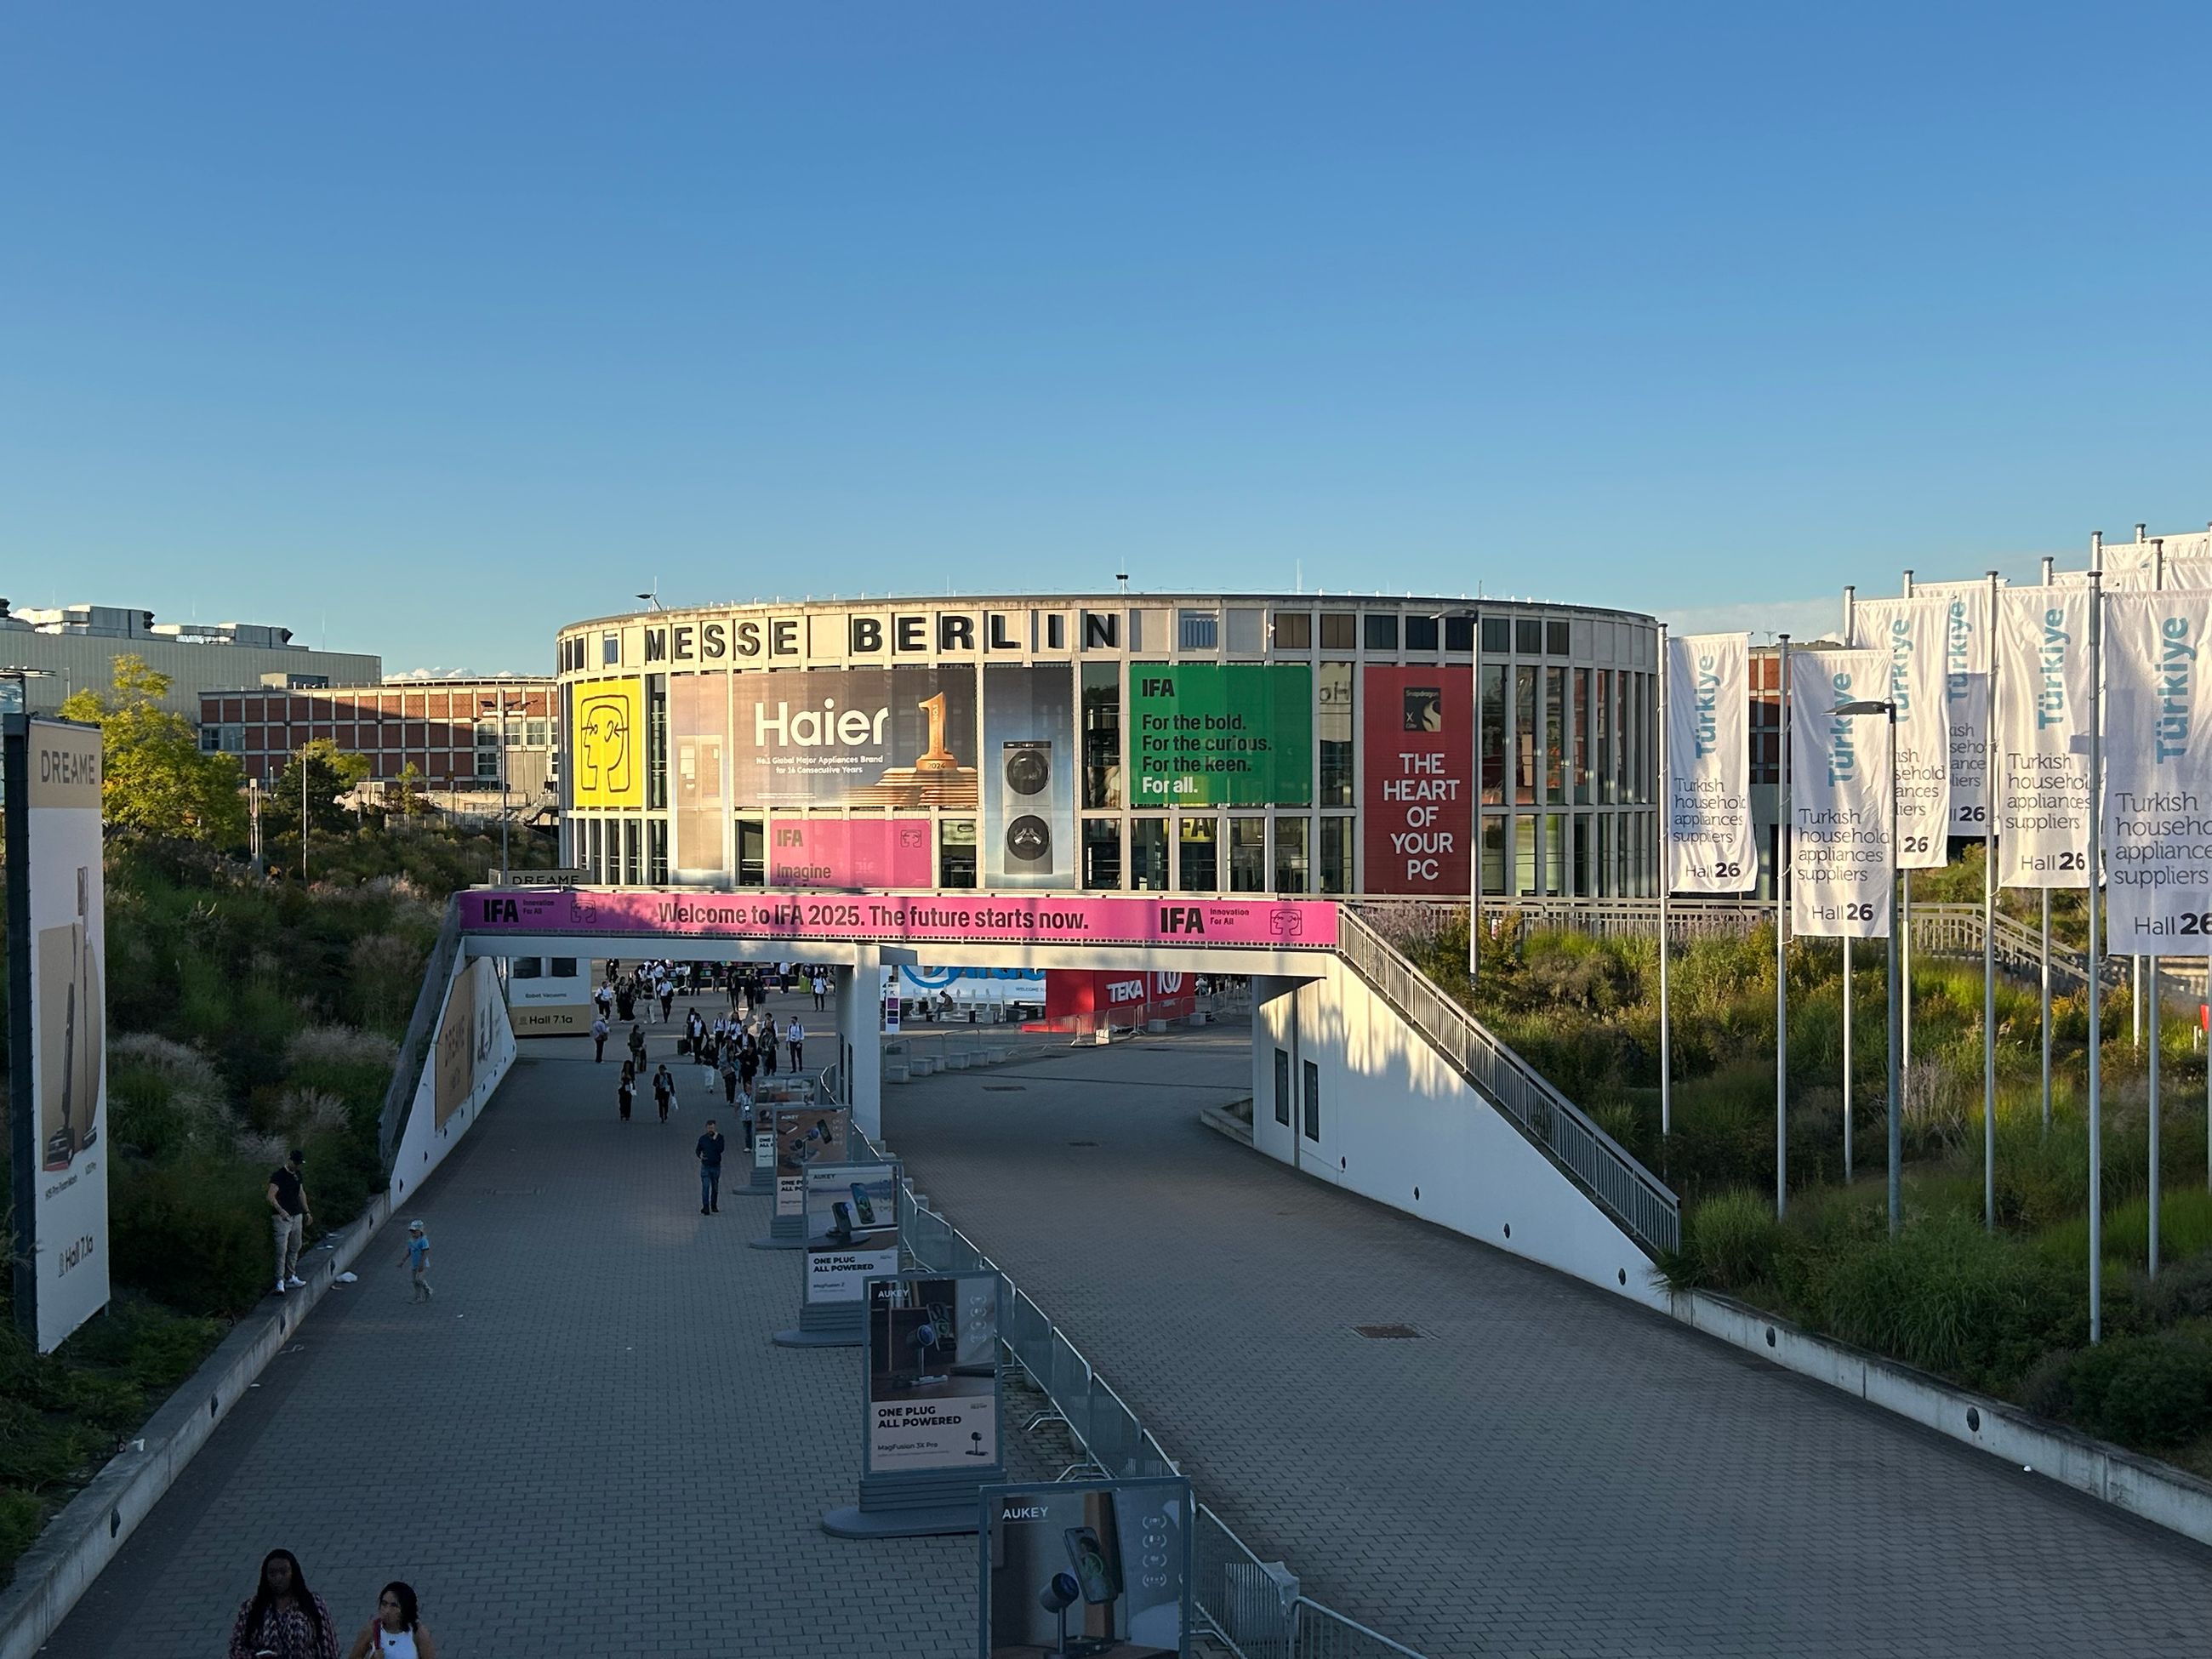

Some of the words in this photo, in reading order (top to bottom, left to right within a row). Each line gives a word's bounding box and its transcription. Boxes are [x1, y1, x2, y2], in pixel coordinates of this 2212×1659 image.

[645, 621, 798, 661] MESSE
[853, 613, 1120, 653] BERLIN
[2038, 608, 2070, 730] Türkiye
[1143, 679, 1175, 697] IFA
[2156, 617, 2196, 764] Türkiye
[1695, 654, 1720, 760] Türkiye
[755, 698, 890, 747] Haier
[1143, 715, 1169, 730] For
[1173, 714, 1200, 730] the
[1205, 714, 1246, 730] bold.
[1405, 711, 1414, 722] X
[1827, 672, 1856, 787] Türkye
[1143, 736, 1169, 751] For
[1173, 735, 1200, 751] the
[1205, 735, 1272, 751] curious.
[41, 750, 94, 784] DREAME
[1143, 757, 1169, 772] For
[1173, 756, 1200, 772] the
[1205, 756, 1251, 772] keen.
[1399, 753, 1445, 774] THE
[2008, 753, 2072, 769] Turkish
[1143, 777, 1170, 794] For
[1173, 777, 1198, 794] all.
[1674, 778, 1725, 793] Turkish
[2008, 772, 2091, 790] househol
[1383, 780, 1461, 801] HEART
[2115, 792, 2198, 812] Turkish
[1406, 807, 1440, 827] OF
[1799, 808, 1861, 824] Turkish
[1959, 806, 1986, 822] 26
[2005, 813, 2081, 833] suppliers
[2115, 816, 2212, 836] househo
[777, 830, 804, 847] IFA
[1390, 833, 1454, 854] YOUR
[1799, 827, 1890, 844] household
[1904, 836, 1929, 852] 26
[1799, 847, 1884, 864] appliances
[2021, 855, 2055, 870] Hall
[2059, 852, 2085, 870] 26
[2115, 841, 2212, 864] appliance
[777, 863, 831, 881] Imagine
[1407, 859, 1440, 881] PC
[1686, 864, 1713, 878] Hall
[1715, 862, 1741, 878] 26
[1798, 866, 1867, 884] suppliers
[2115, 866, 2209, 889] suppliers
[512, 875, 579, 885] DREAME
[483, 899, 520, 922] IFA
[658, 903, 746, 924] Welcome
[751, 905, 770, 925] to
[774, 904, 804, 925] IFA
[808, 905, 865, 926] 2025.
[869, 905, 905, 926] The
[910, 905, 970, 927] future
[975, 908, 1035, 928] starts
[1039, 913, 1089, 929] now.
[1210, 908, 1249, 916] Innovation
[1812, 904, 1844, 920] Hall
[1846, 903, 1873, 921] 26
[1160, 907, 1205, 933] IFA
[2135, 916, 2175, 935] Hall
[2180, 912, 2212, 935] 26
[1106, 979, 1143, 1003] TEKA
[529, 1015, 550, 1024] Hall
[65, 1240, 80, 1274] Hall
[831, 1263, 874, 1272] POWERED
[878, 1289, 909, 1299] AUKEY
[878, 1407, 903, 1417] ONE
[905, 1405, 936, 1416] PLUG
[878, 1420, 900, 1428] ALL
[903, 1416, 961, 1428] POWERED
[1002, 1506, 1049, 1520] AUKEY
